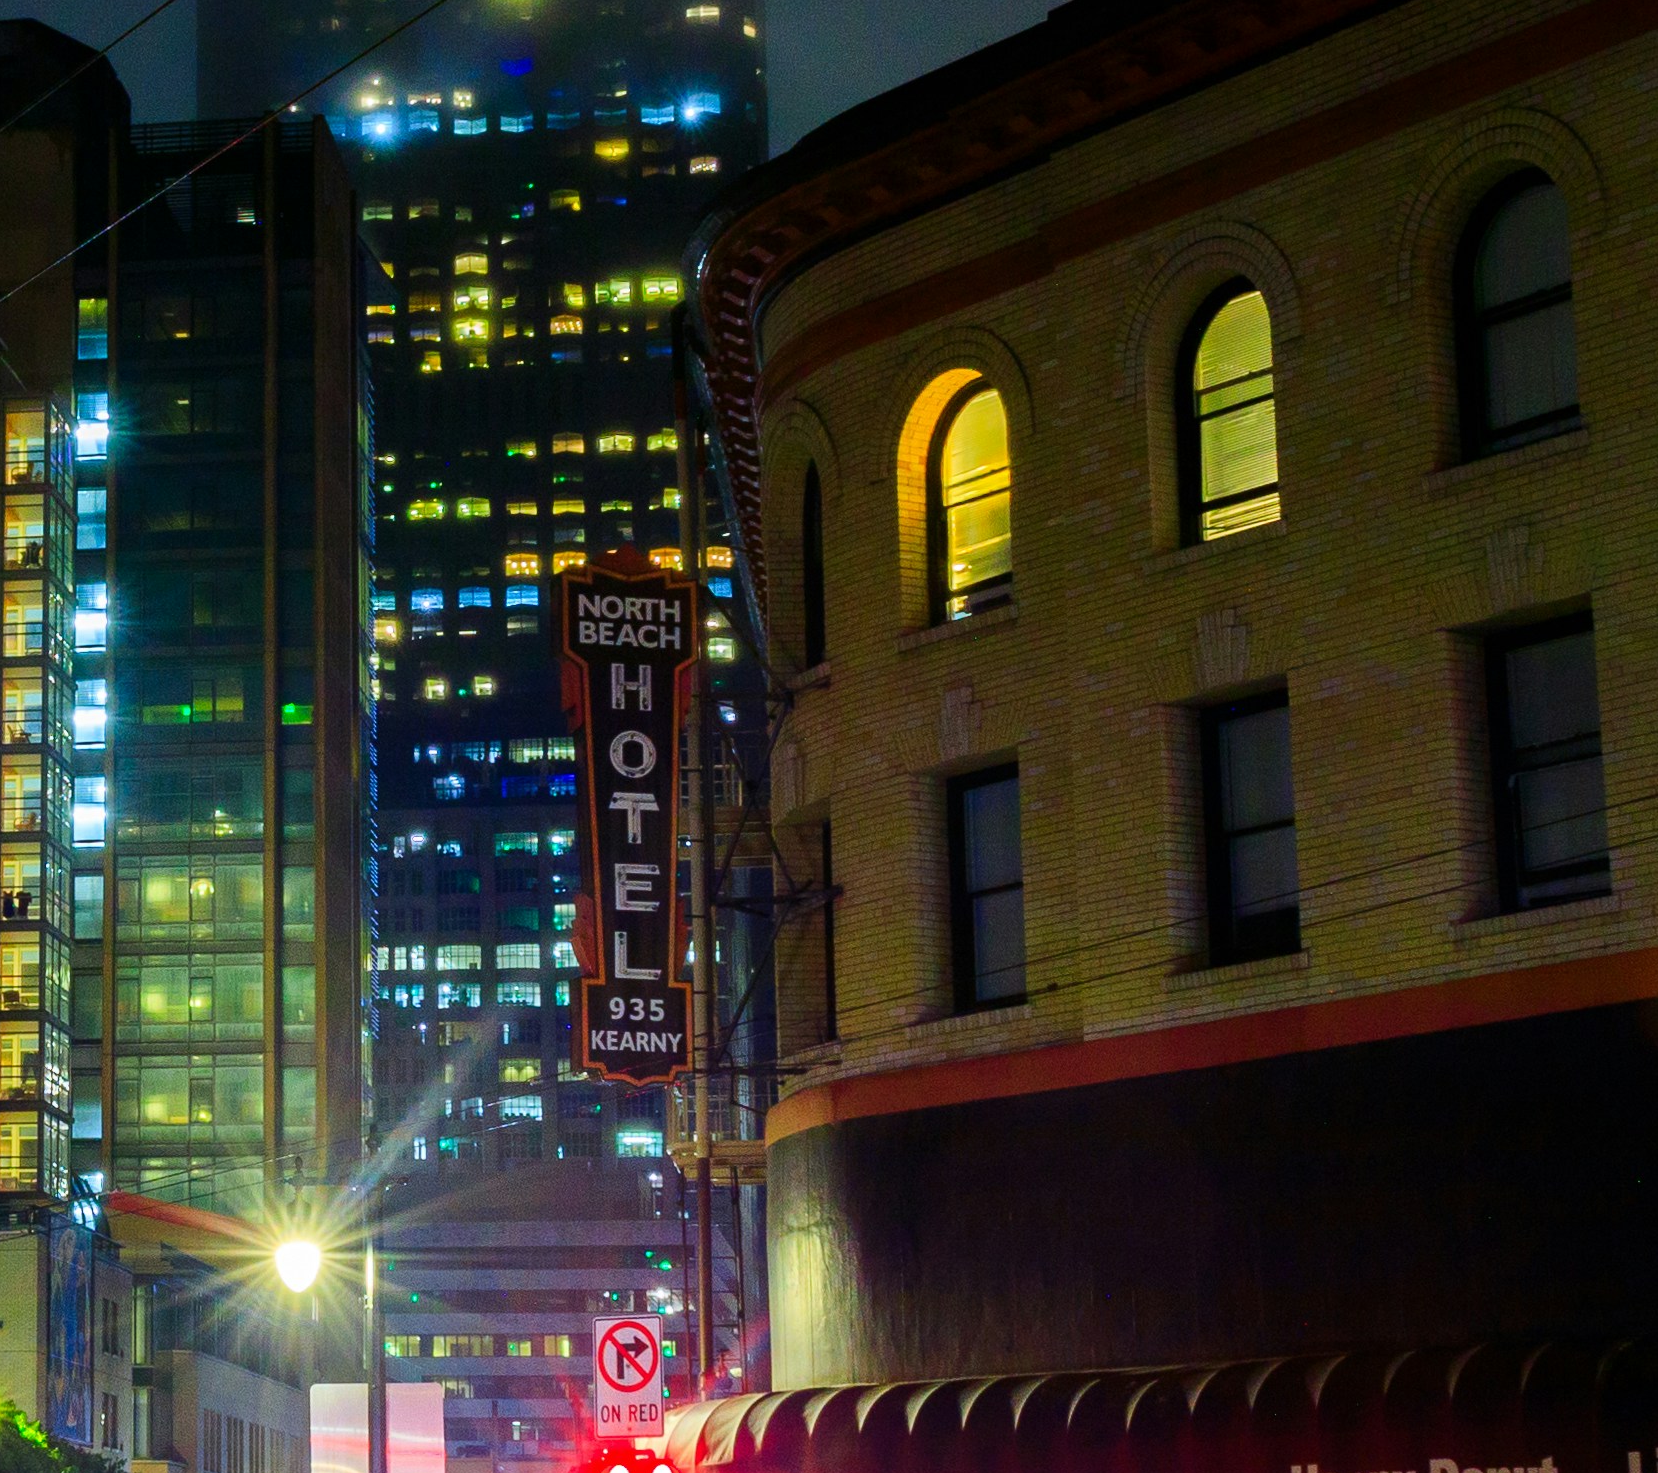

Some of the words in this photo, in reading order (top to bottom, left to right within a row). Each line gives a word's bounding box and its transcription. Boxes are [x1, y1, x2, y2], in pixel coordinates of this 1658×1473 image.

[578, 593, 681, 623] NORTH
[579, 621, 681, 650] BEACH
[609, 662, 662, 980] HOTEL
[609, 996, 665, 1023] 935
[591, 1030, 682, 1054] KEARNY
[601, 1405, 621, 1423] ON
[628, 1404, 658, 1422] RED
